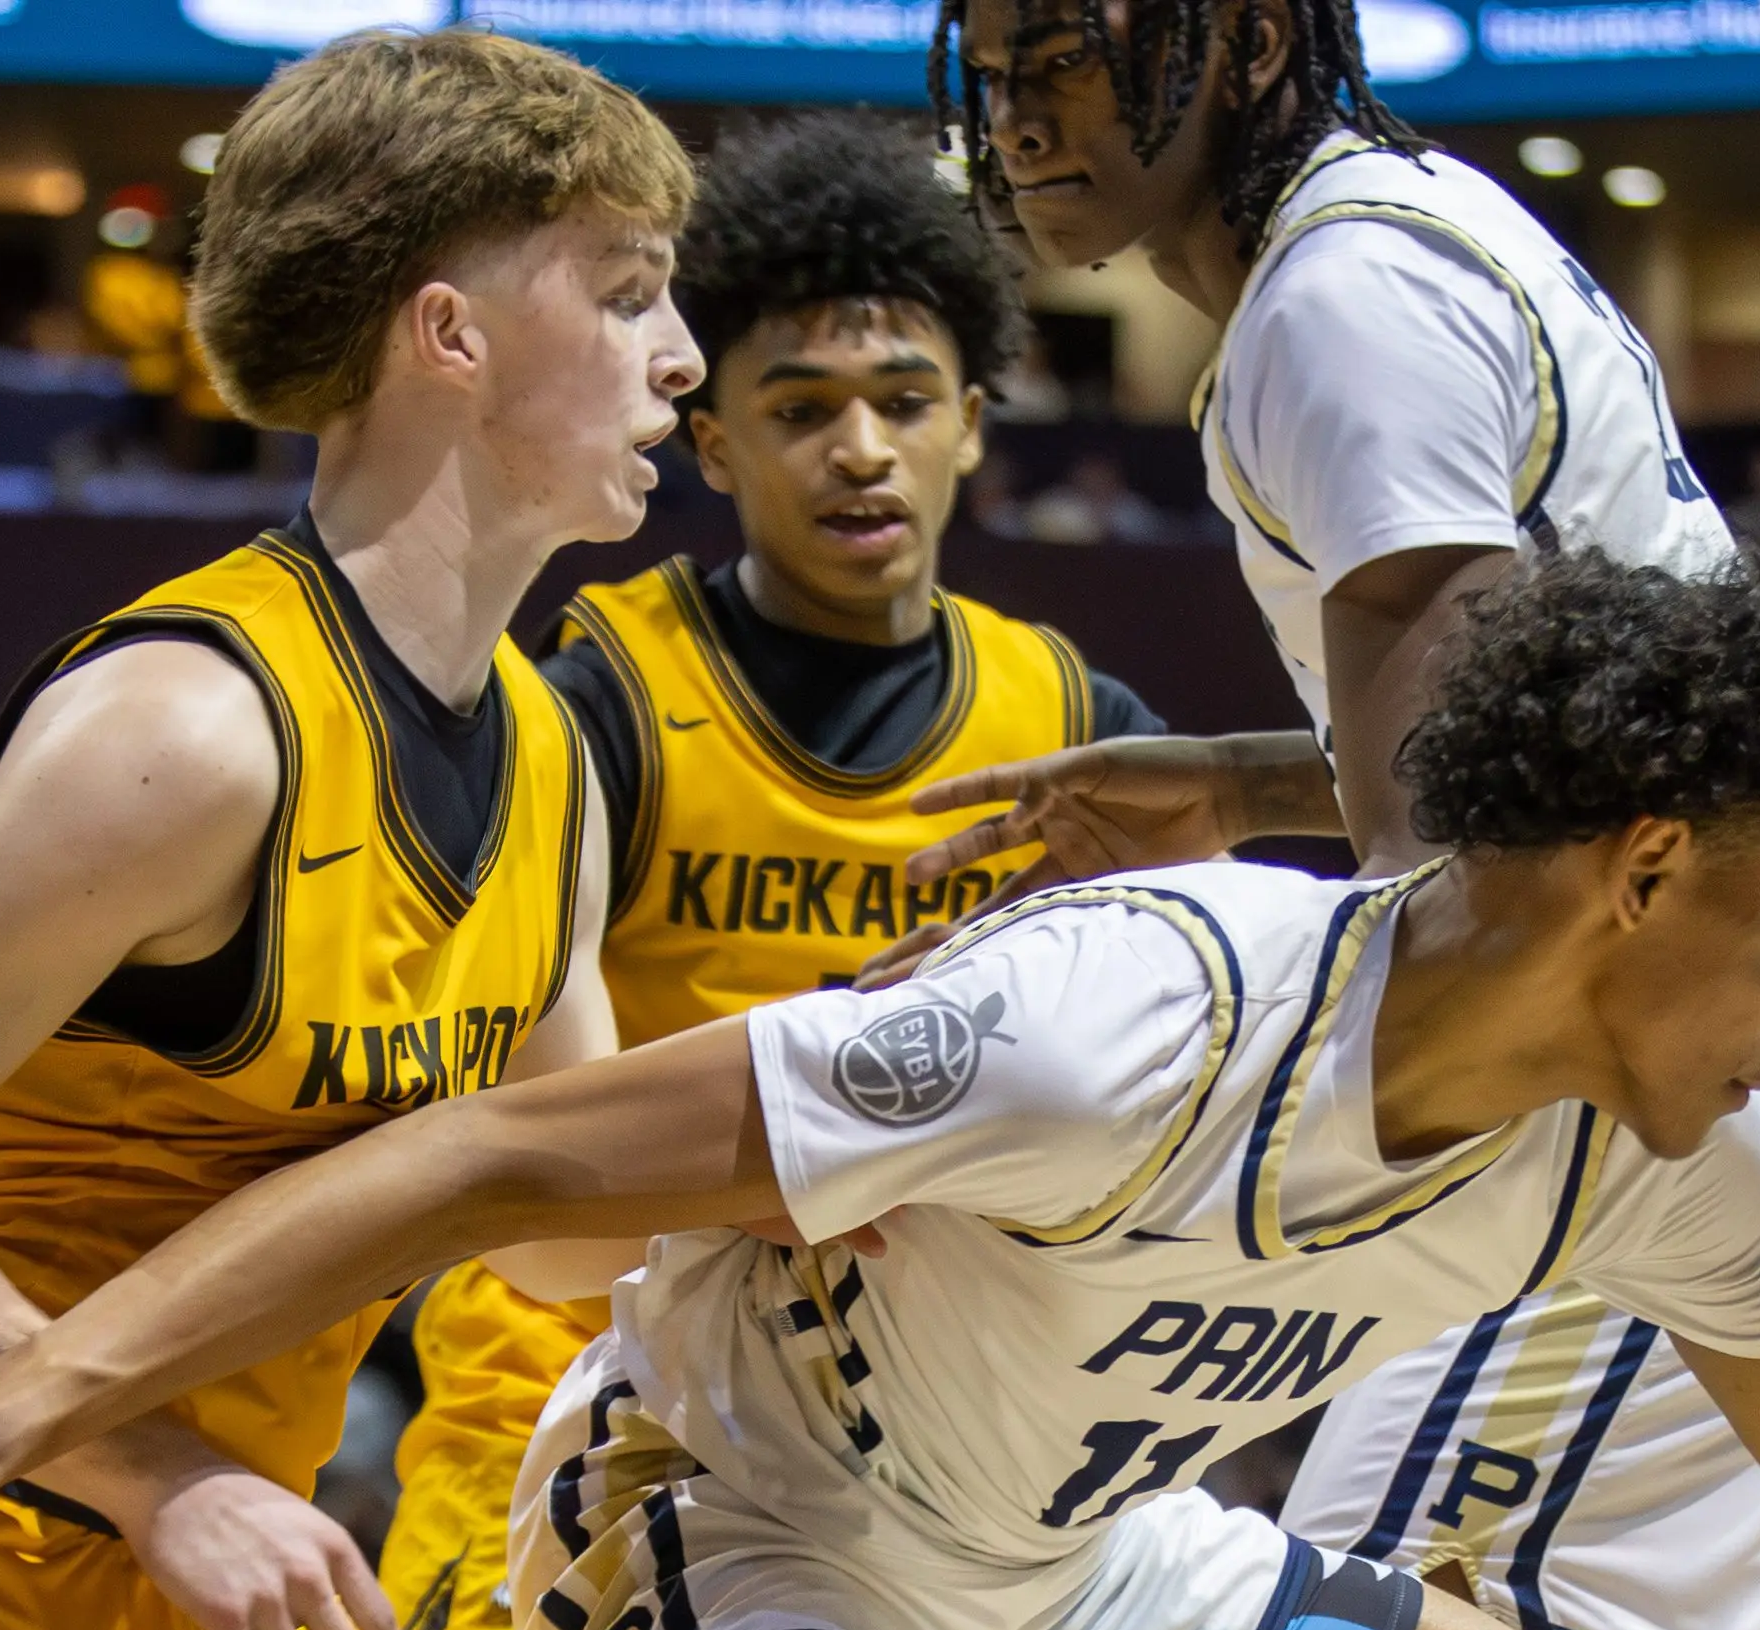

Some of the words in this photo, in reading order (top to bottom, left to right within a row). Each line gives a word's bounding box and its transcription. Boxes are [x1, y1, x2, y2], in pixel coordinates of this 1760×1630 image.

[666, 849, 1019, 939] KICKAPO
[290, 1005, 530, 1110] KICKPO
[898, 1014, 939, 1103] EYBL
[1075, 1300, 1383, 1402] PRIN
[1037, 1419, 1225, 1528] 11
[1426, 1439, 1539, 1530] P
